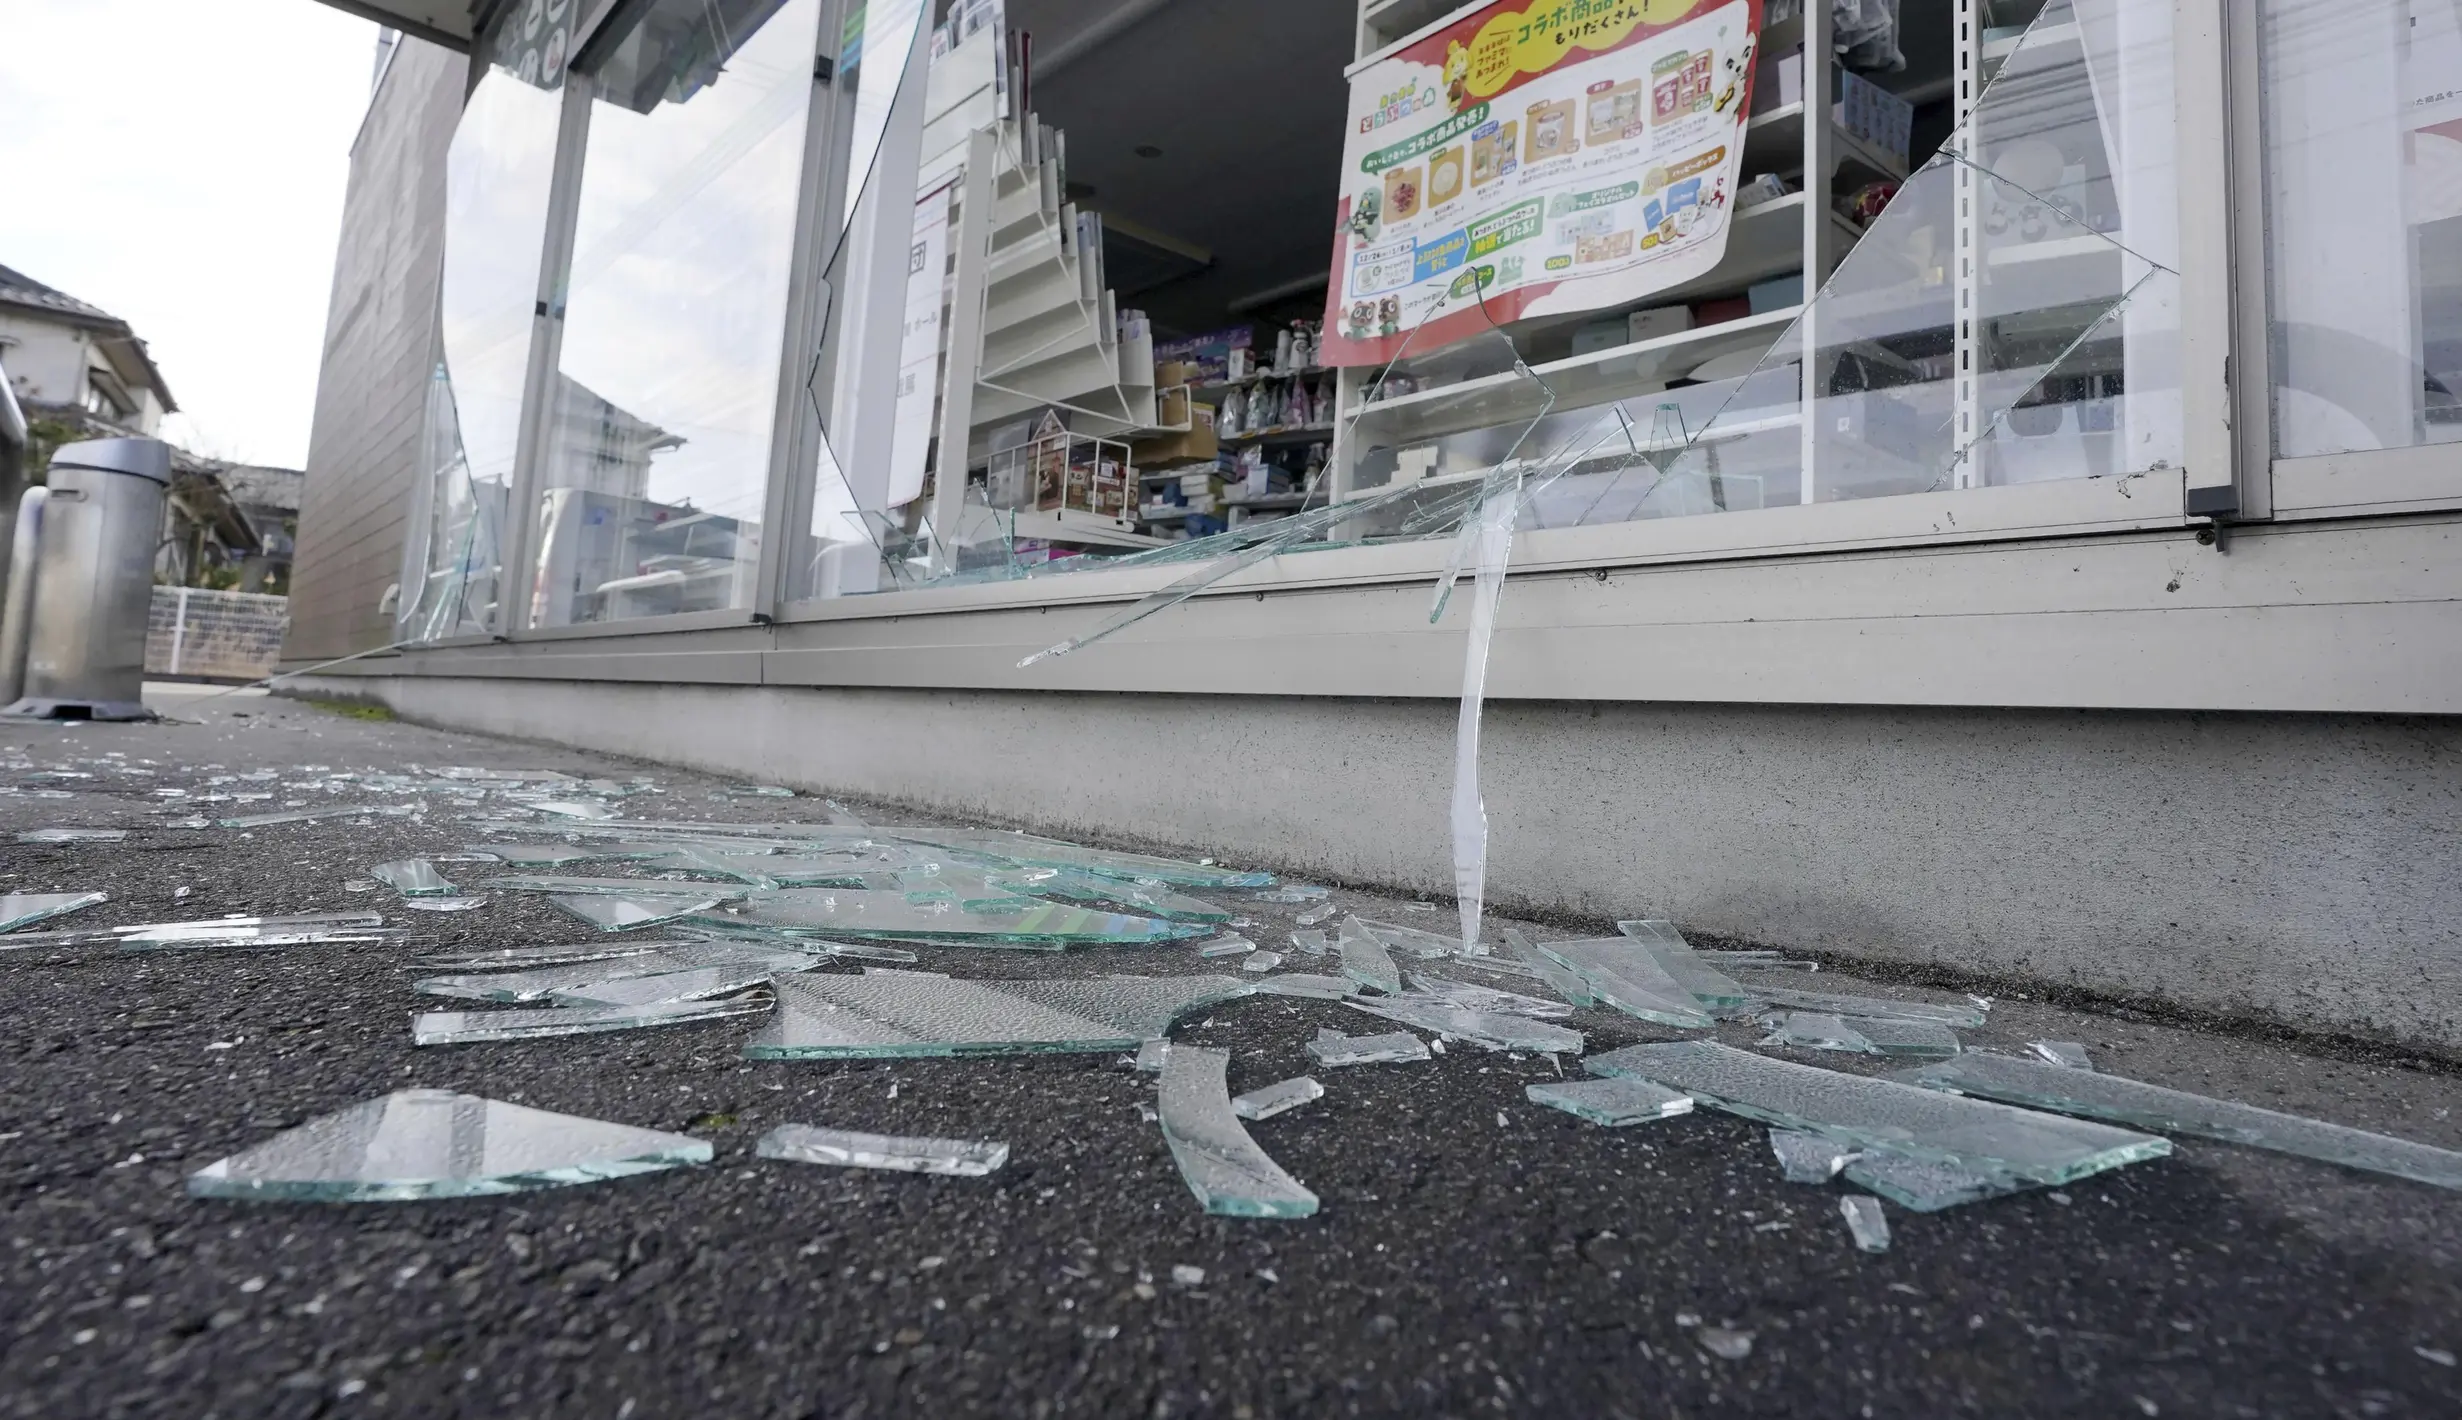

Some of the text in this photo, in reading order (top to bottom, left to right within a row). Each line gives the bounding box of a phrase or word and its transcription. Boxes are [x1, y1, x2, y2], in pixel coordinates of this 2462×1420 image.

[1517, 0, 1625, 45] コラボ商品
[1554, 0, 1649, 46] もりだくさん!
